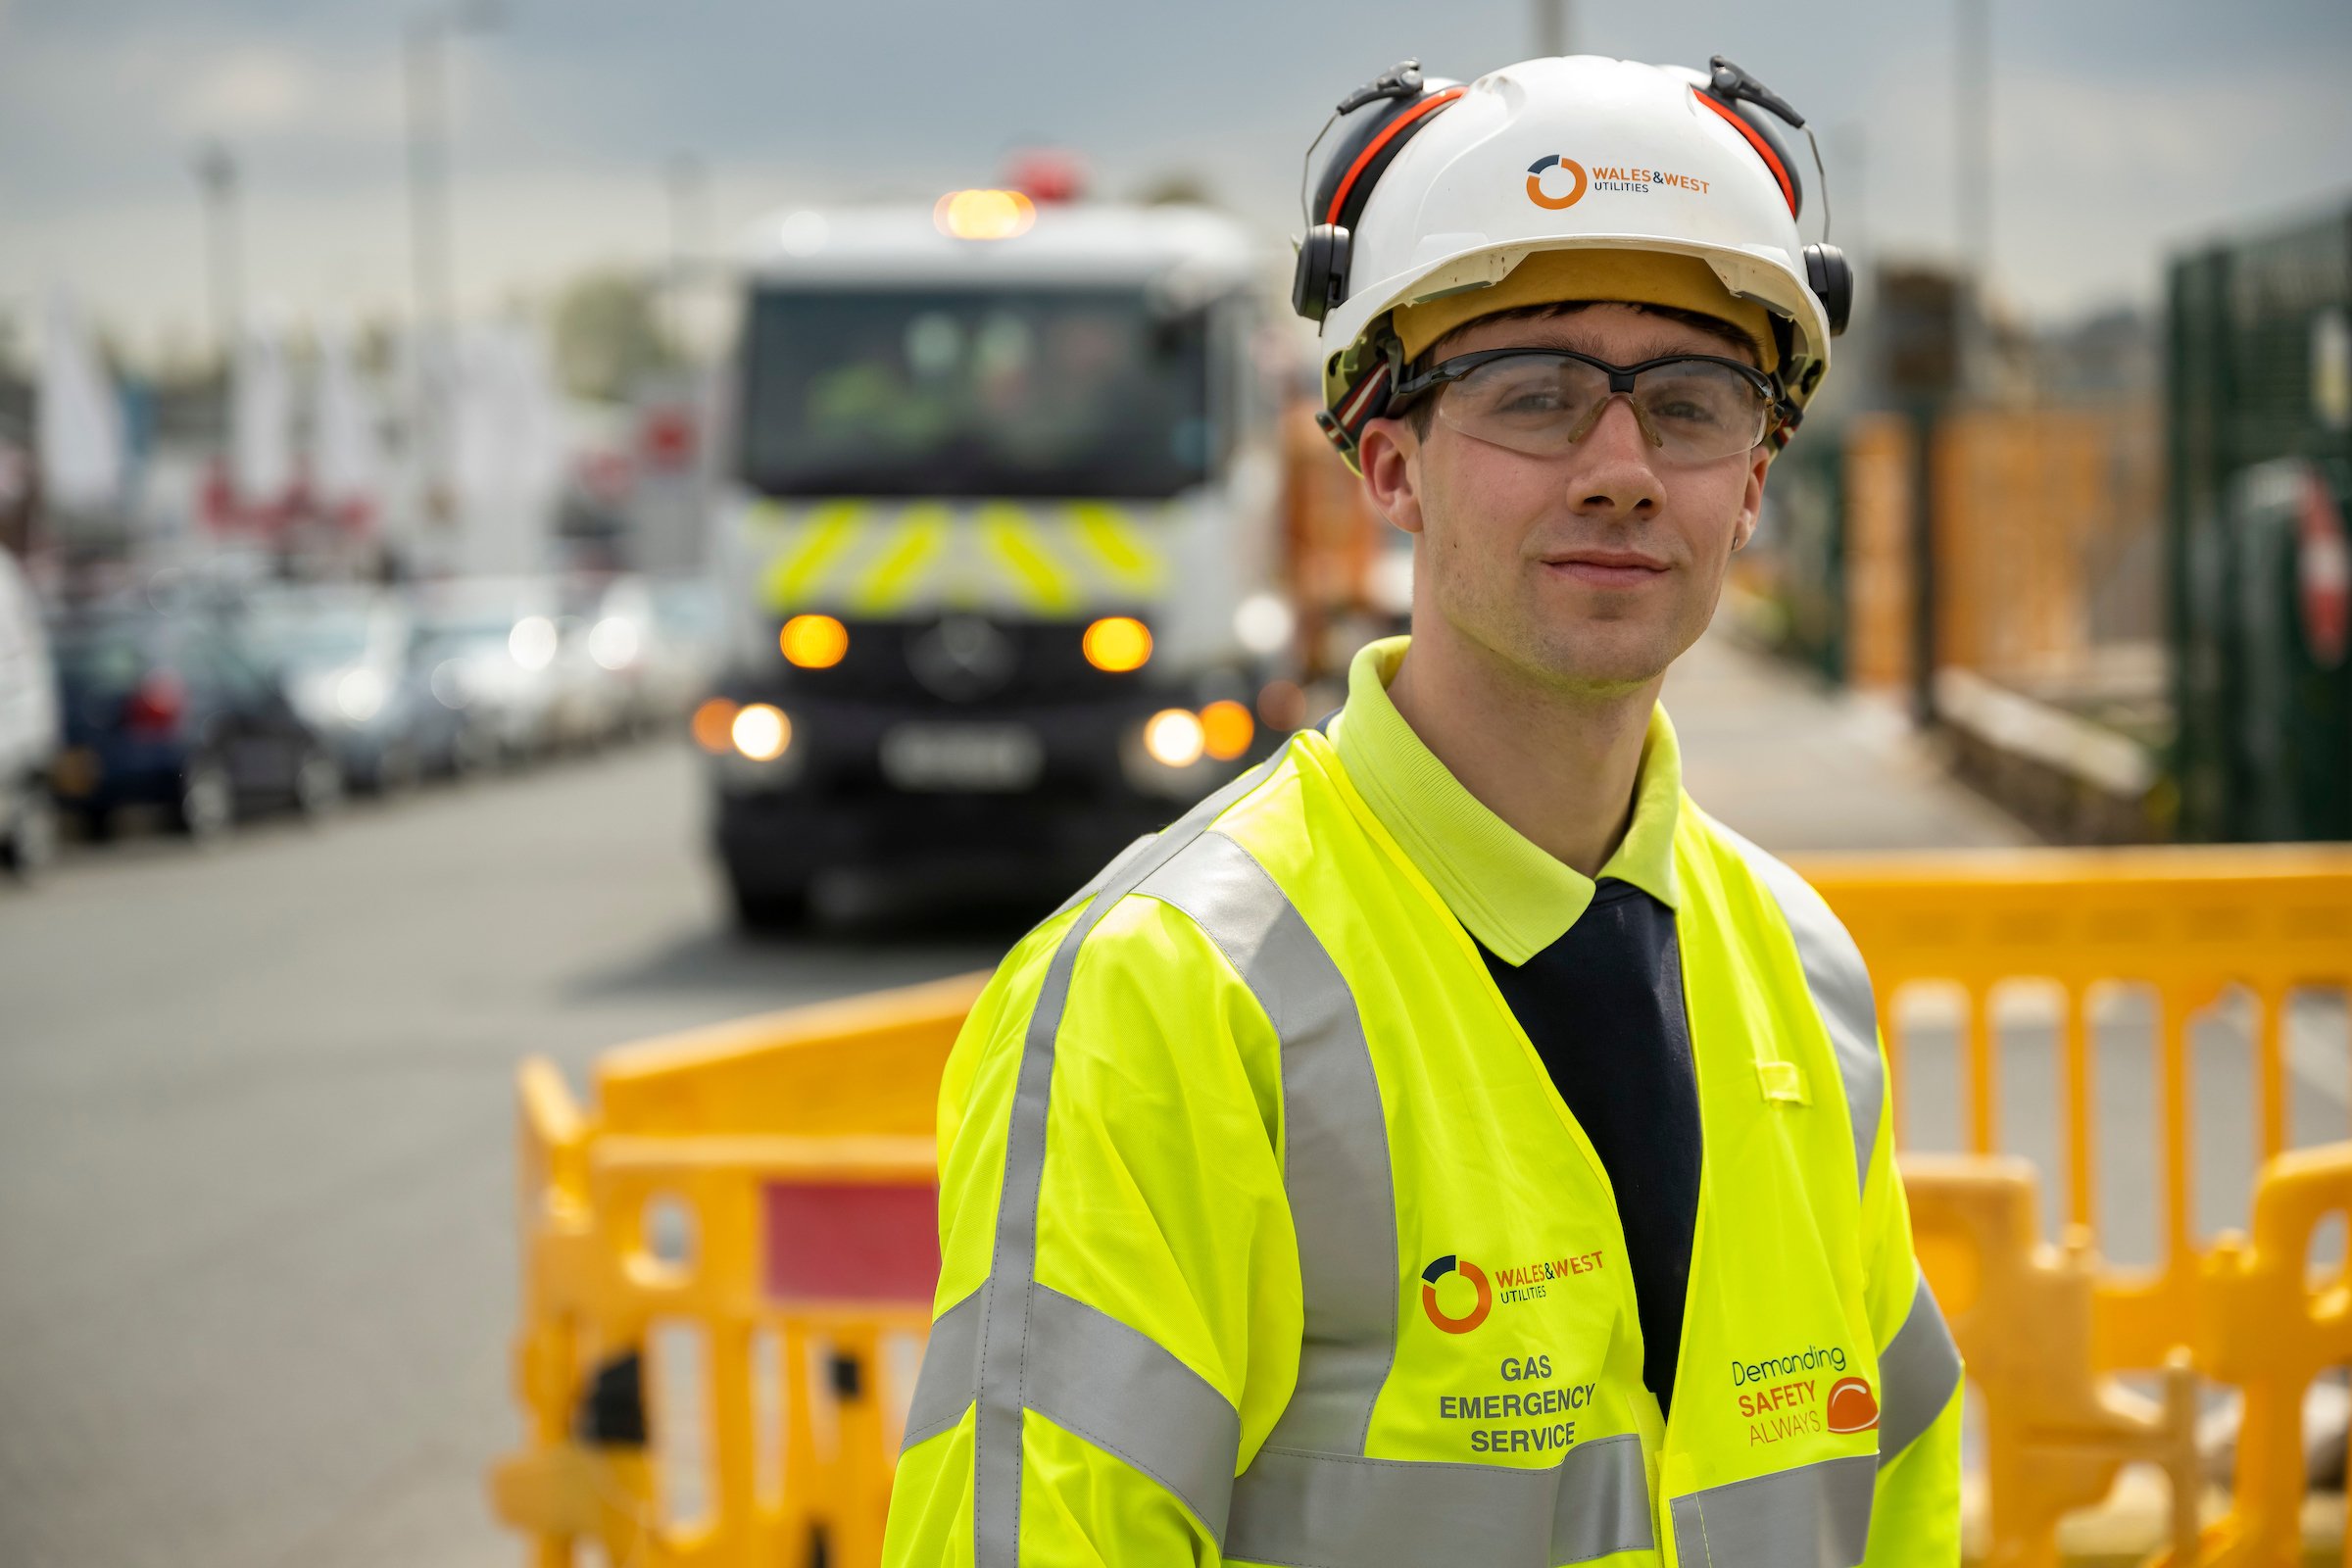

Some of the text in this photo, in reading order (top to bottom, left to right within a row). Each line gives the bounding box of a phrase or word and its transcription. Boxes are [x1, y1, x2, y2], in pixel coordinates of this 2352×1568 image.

[1592, 168, 1710, 194] WALES&WEST
[1594, 181, 1649, 193] UTILITIES
[1494, 1250, 1603, 1288] WALES&WEST
[1500, 1285, 1546, 1304] UTILITIES
[1500, 1354, 1552, 1382] GAS
[1732, 1345, 1846, 1387] Demanding
[1440, 1383, 1595, 1419] EMERGENCY
[1739, 1380, 1815, 1418] SAFETY
[1471, 1422, 1575, 1452] SERVICE
[1750, 1410, 1821, 1446] ALWAYS
